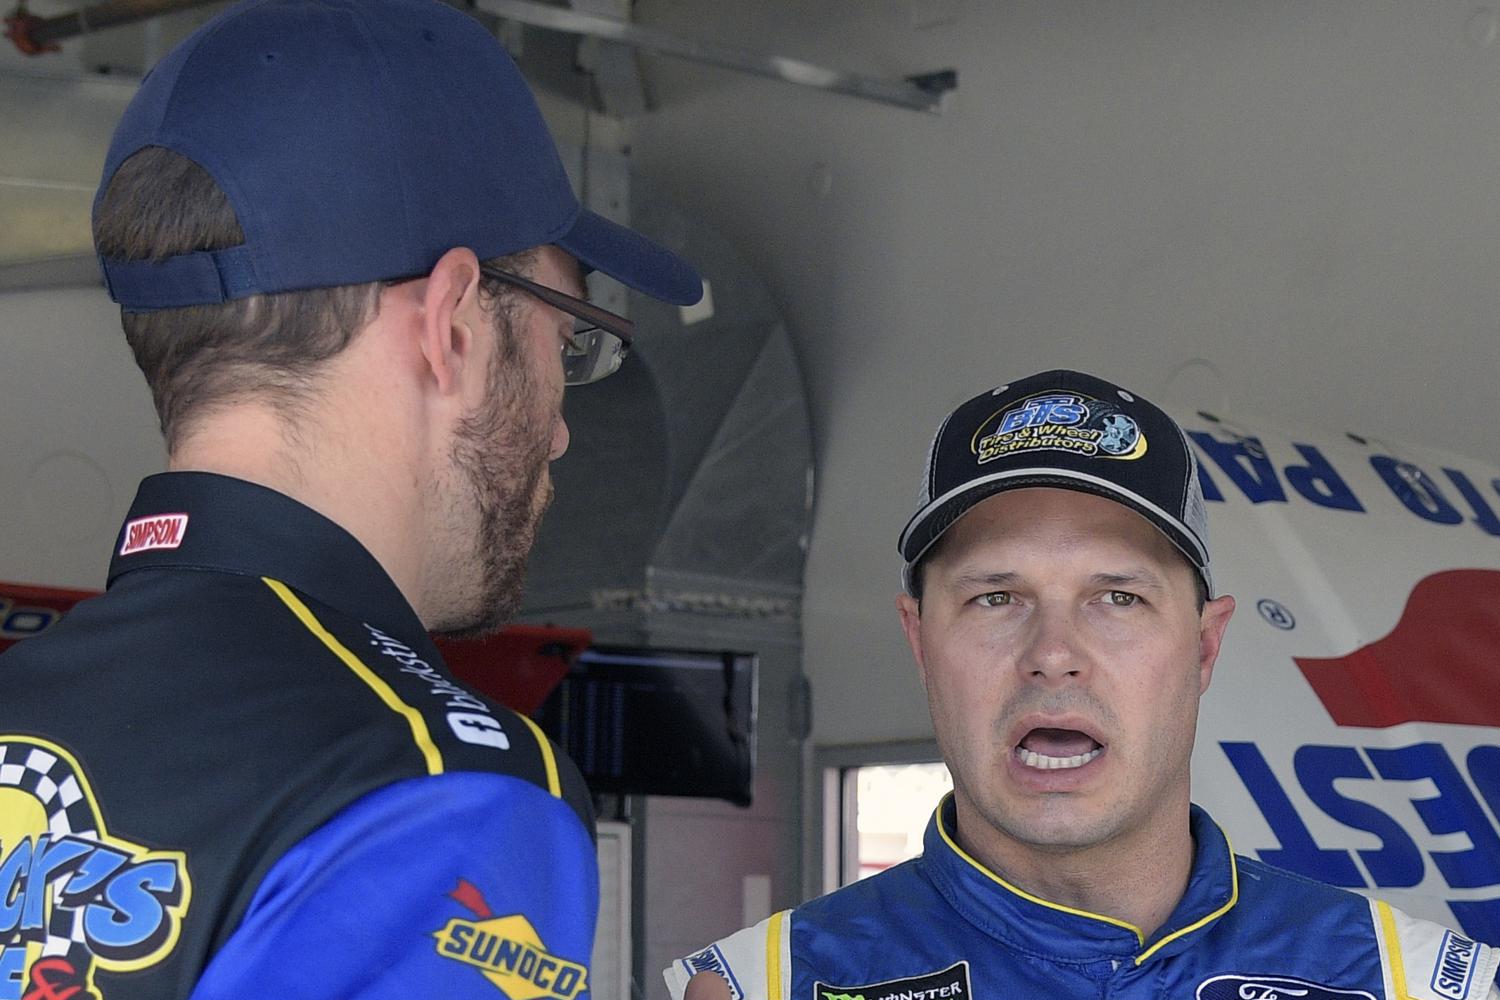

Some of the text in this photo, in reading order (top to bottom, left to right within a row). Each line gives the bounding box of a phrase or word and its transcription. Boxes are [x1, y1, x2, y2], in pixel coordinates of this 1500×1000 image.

[999, 395, 1088, 434] BTS
[980, 437, 1097, 458] Distributors
[981, 432, 1015, 449] Tire
[1038, 425, 1100, 441] Wheel
[124, 518, 182, 551] SIMPSON
[443, 923, 582, 997] SUNOCO
[1438, 934, 1474, 994] SIMPSON
